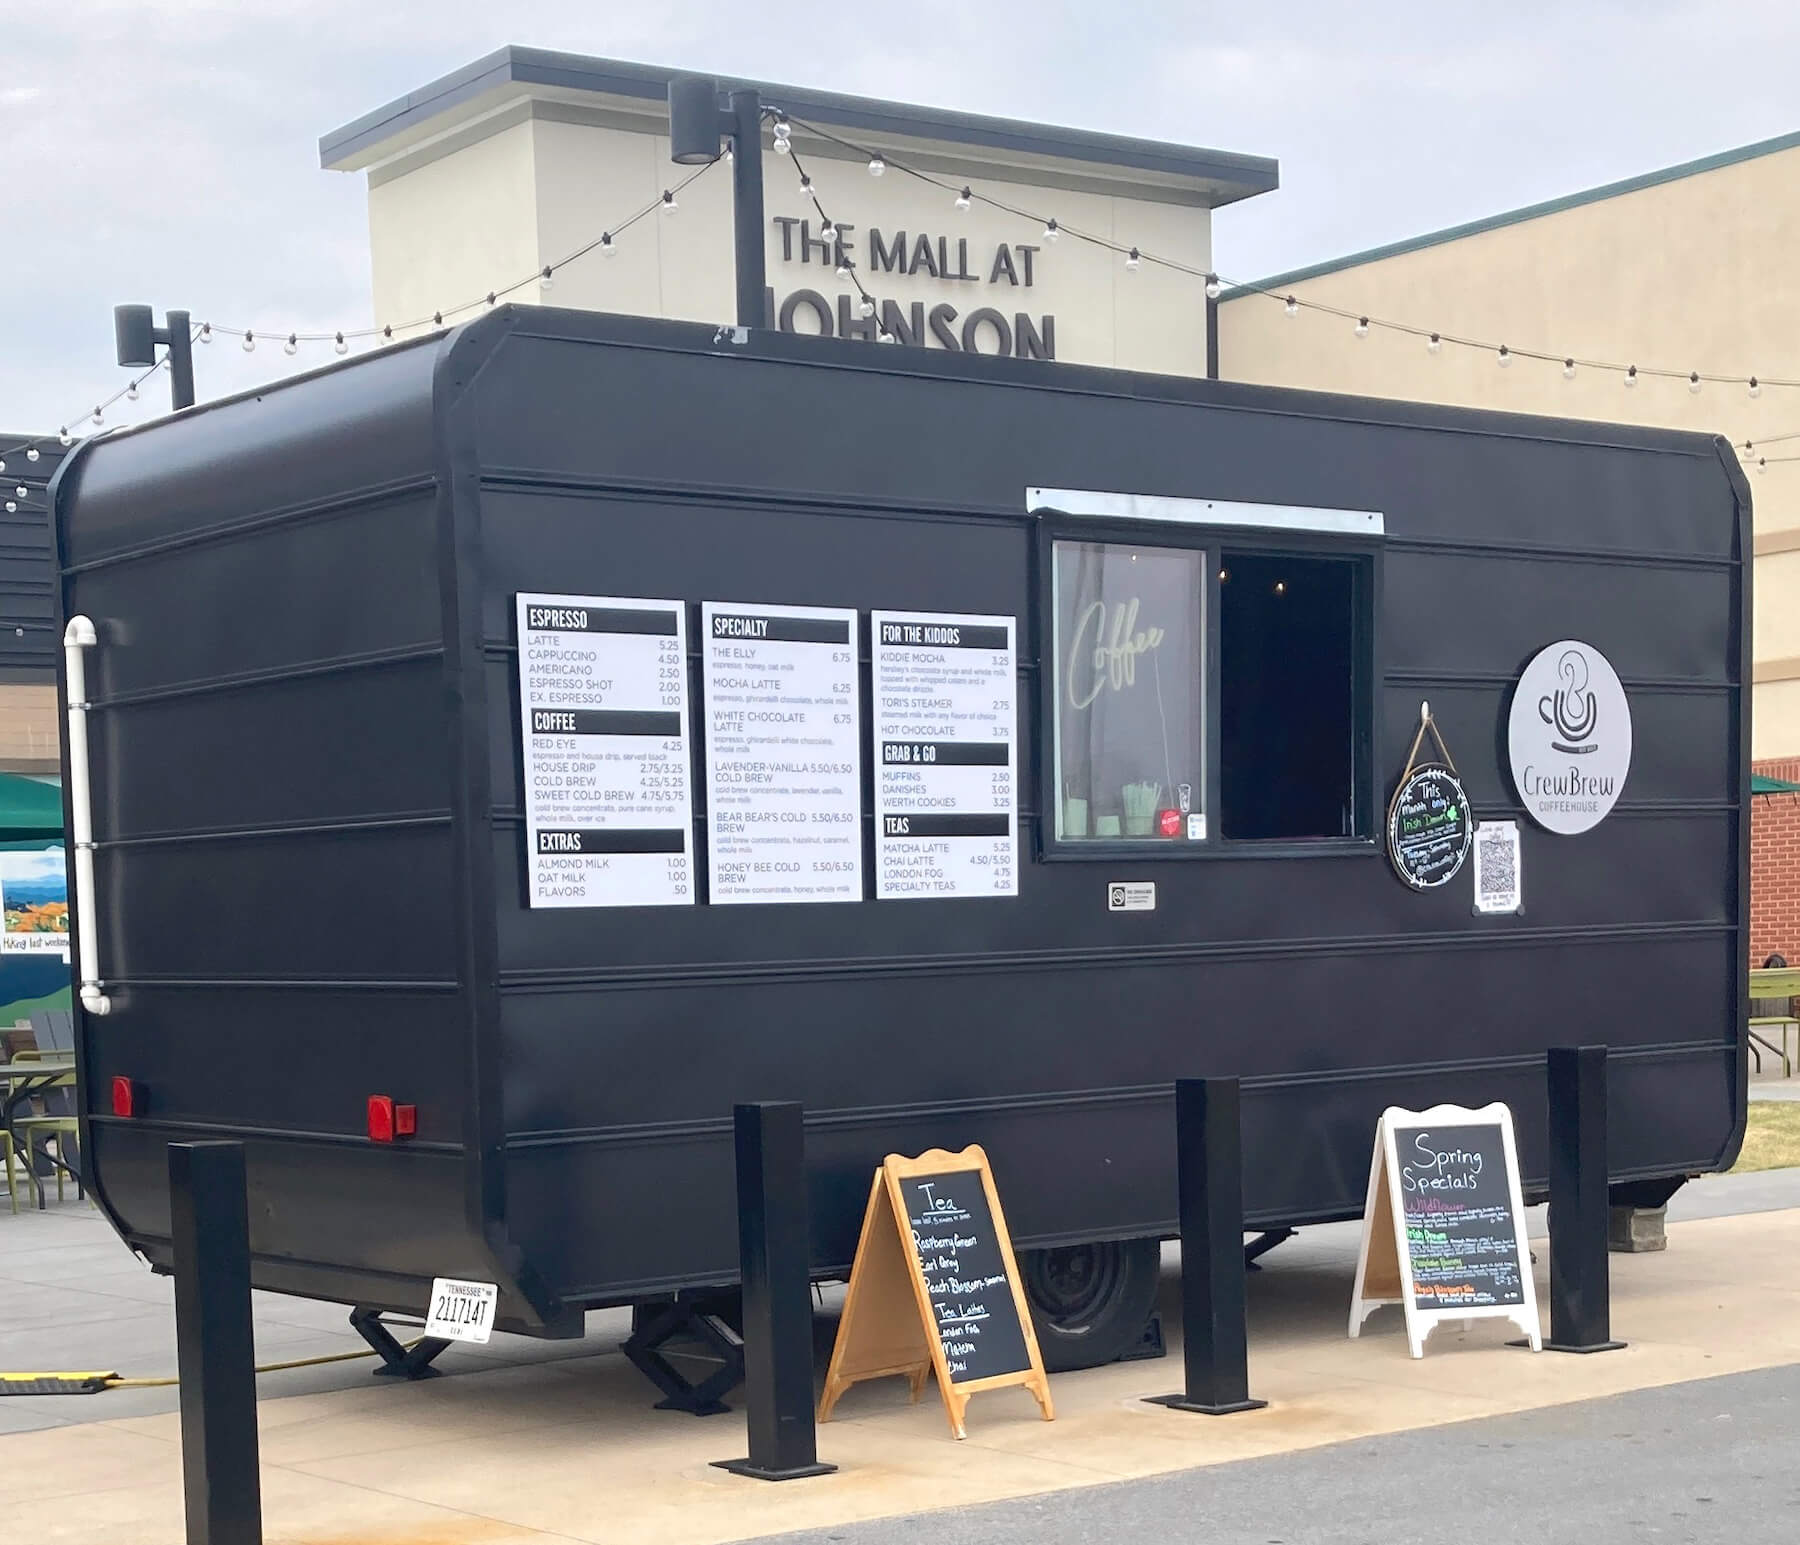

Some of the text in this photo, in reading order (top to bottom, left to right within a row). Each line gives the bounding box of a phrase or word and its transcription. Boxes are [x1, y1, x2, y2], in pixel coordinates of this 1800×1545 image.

[773, 216, 1040, 287] THE MALL AT
[529, 608, 588, 629] ESPRESSO
[714, 617, 769, 637] SPECIALTY
[883, 625, 960, 645] FOR THE KIDDOS
[528, 635, 679, 651] LATTE 5.25
[528, 649, 679, 665] CAPPUCCINO 4.50
[712, 647, 851, 663] THE ELLY 6.75
[880, 652, 910, 663] KIDDIE
[912, 653, 945, 664] MOCHA
[1069, 598, 1164, 710] Coffee
[529, 664, 680, 679] AMERICANO 2.50
[529, 677, 680, 692] ESPRESSO SHOT 2.00
[713, 677, 851, 693] MOCHA LATTE 6.25
[530, 691, 681, 706] EX. ESPRESSO 1.00
[881, 697, 1009, 710] TORI'S STEAMER 2.75
[534, 712, 577, 731] COFFEE
[714, 711, 851, 724] WHITE CHOCOLATE 6.75
[714, 722, 743, 732] LATTE
[881, 725, 1009, 737] HOT CHOCOLATE 3.75
[532, 738, 682, 751] RED EYE 4.25
[884, 744, 936, 762] GRAB & GO
[533, 762, 683, 774] HOUSE DRIP 2.75/3.25
[715, 762, 852, 774] LAVENDER-VANILLA 5.50/6.50
[534, 776, 684, 787] COLD BREW 4.25/5.25
[715, 773, 773, 783] COLD BREW
[882, 771, 1010, 782] MUFFINS 2.50
[1523, 765, 1614, 797] CrewBrew
[534, 790, 685, 801] SWEET COLD BREW 4.75/5.75
[882, 784, 1010, 794] DANISHES 3.00
[1418, 781, 1441, 799] This
[883, 797, 1010, 807] WERTH COOKIES 3.25
[1538, 800, 1599, 813] COFFEEHOUSE
[716, 812, 853, 824] BEAR BEAR'S COLD 5.50/6.50
[1402, 817, 1422, 832] Irish
[716, 823, 745, 833] BREW
[885, 817, 910, 833] TEAS
[540, 832, 582, 851] EXTRAS
[883, 844, 919, 853] MATCHA
[922, 843, 949, 853] LATTE
[537, 857, 686, 869] ALMOND MILK 1.00
[717, 861, 854, 873] HONEY BEE COLD 5.50/6.50
[883, 856, 905, 866] CHAI
[907, 856, 934, 865] LATTE
[537, 871, 687, 883] OAT MILK 1.00
[718, 873, 746, 884] BREW
[884, 869, 923, 879] LONDON
[925, 868, 944, 878] FOG
[538, 884, 687, 897] FLAVORS .50
[884, 881, 931, 892] SPECIALTY
[933, 880, 956, 890] TEAS
[1411, 1133, 1483, 1175] Spring
[1402, 1166, 1478, 1195] Specials
[917, 1182, 958, 1211] Tea
[447, 1284, 482, 1298] TENNESSEE
[923, 1276, 951, 1294] Peach
[435, 1295, 488, 1326] 211714T
[934, 1302, 958, 1319] Tea
